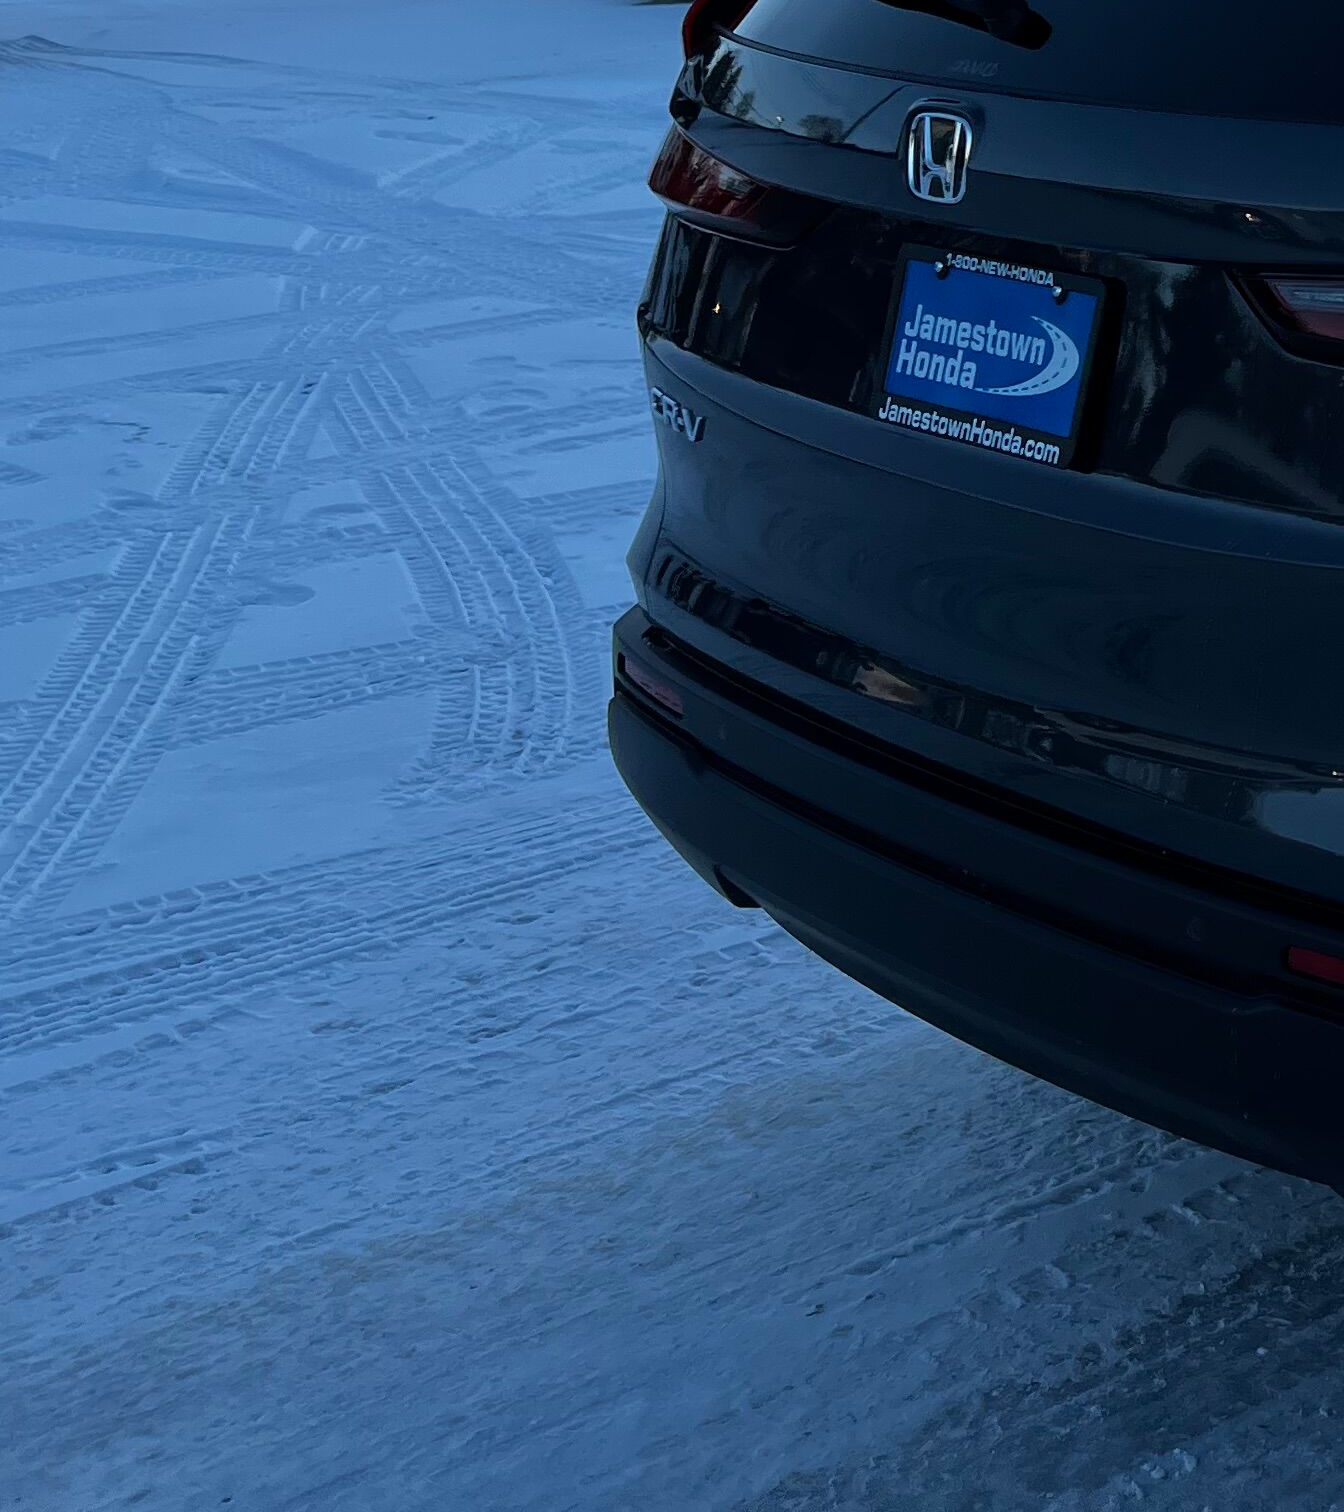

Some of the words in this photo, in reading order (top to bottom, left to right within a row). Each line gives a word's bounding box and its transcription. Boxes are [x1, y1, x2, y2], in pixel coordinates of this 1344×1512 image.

[946, 252, 1054, 287] 1-800-NEW-HONDA
[904, 303, 1046, 366] Jamestown
[896, 338, 977, 389] Honda
[878, 396, 1060, 465] JamestownHonda.com
